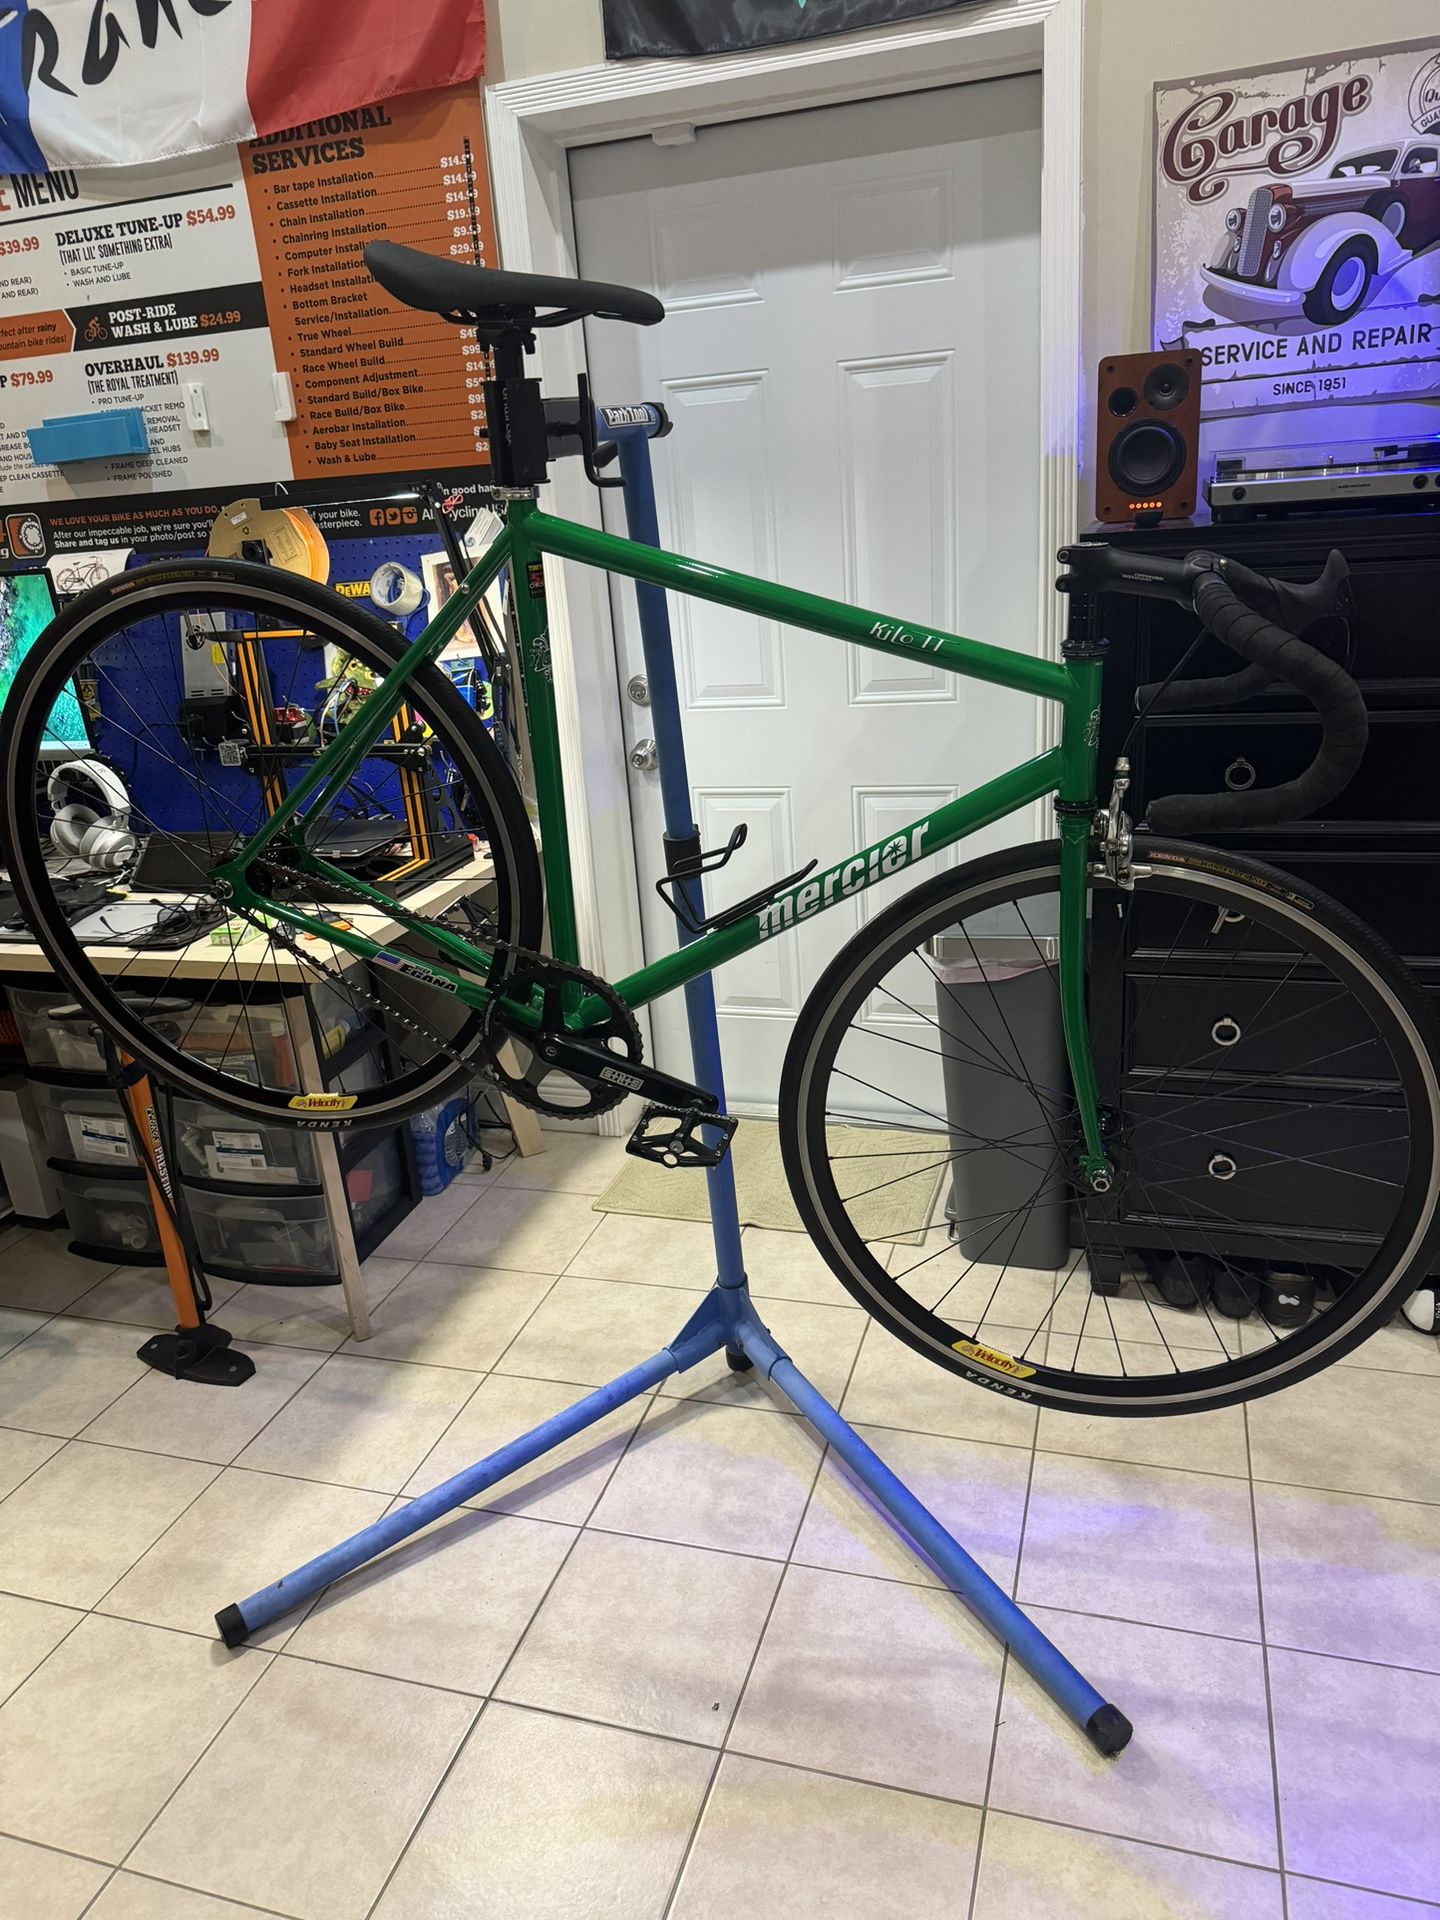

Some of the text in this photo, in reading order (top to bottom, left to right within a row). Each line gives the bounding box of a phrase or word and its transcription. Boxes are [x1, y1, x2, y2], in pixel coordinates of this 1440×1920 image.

[1162, 76, 1372, 203] Garage
[252, 137, 365, 174] SERVICES
[10, 169, 80, 209] MENU
[273, 183, 290, 194] Bar
[292, 180, 315, 192] tape
[318, 170, 374, 187] Installation
[276, 196, 319, 211] Cassette
[321, 187, 377, 204] Installation
[55, 204, 236, 247] DELUXE TUNE-UP $54.99
[280, 214, 307, 228] Chain
[309, 207, 365, 223] Installation
[282, 229, 329, 245] Chainring
[331, 222, 387, 238] Installation
[99, 239, 143, 259] SOMETHING
[144, 233, 173, 251] EXTRA)
[285, 246, 332, 261] Computer
[70, 261, 124, 277] BASIC TUNE-UP
[287, 266, 309, 278] Fork
[10, 276, 32, 286] REAR)
[72, 272, 131, 288] WASH AND LUBE
[290, 280, 329, 294] Headset
[1, 287, 39, 299] AND REAR)
[292, 292, 368, 310] Bottom Bracket
[108, 303, 177, 324] POST-RIDE
[295, 307, 389, 326] Service/Installation
[17, 325, 36, 336] after
[111, 310, 241, 339] WASH & LUBE $24.99
[27, 336, 44, 347] bike
[297, 327, 352, 342] True Wheel
[1201, 322, 1432, 366] SERVICE AND REPAIR
[300, 337, 404, 358] Standard Wheel Build
[84, 348, 220, 377] OVERHAUL $139.99
[302, 355, 385, 374] Race Wheel Build
[10, 369, 54, 388] $79.99
[106, 376, 129, 392] ROYAL
[305, 368, 419, 389] Component Adjustment
[1273, 377, 1347, 396] SINCE 1951
[97, 393, 145, 406] PRO TUNE-UP
[307, 383, 424, 405] Standard Build/Box Bike
[147, 415, 181, 426] REMOVAL
[309, 401, 405, 421] Race Build/Box Bike
[149, 423, 181, 434] HEADSET
[312, 418, 406, 436] Aerobar Installation
[314, 433, 417, 452] Baby Seat Installation
[111, 456, 189, 471] FRAME DEEP CLEANED
[316, 451, 377, 466] Wash & Lube
[9, 469, 65, 482] CLEAN CASSETTE
[113, 469, 173, 481] FRAME POLISHED
[452, 485, 477, 496] good
[49, 518, 64, 527] WE
[65, 515, 86, 525] LOVE
[87, 513, 110, 524] YOUR
[111, 512, 131, 522] BIKE
[132, 511, 144, 520] AS
[145, 509, 170, 519] MUCH
[171, 507, 183, 516] AS
[184, 506, 203, 515] YOU
[318, 511, 338, 522] your
[53, 530, 72, 540] After
[73, 530, 87, 538] our
[88, 526, 132, 539] impeccable
[173, 522, 189, 531] sure
[54, 530, 207, 549] Share and tag us in your photo/post so
[869, 621, 914, 644] Kilo
[755, 821, 930, 940] mercier
[307, 1098, 342, 1109] Velocity
[296, 1120, 353, 1128] KENDA
[974, 1348, 1016, 1371] Velocity
[965, 1370, 1032, 1399] KENDA
